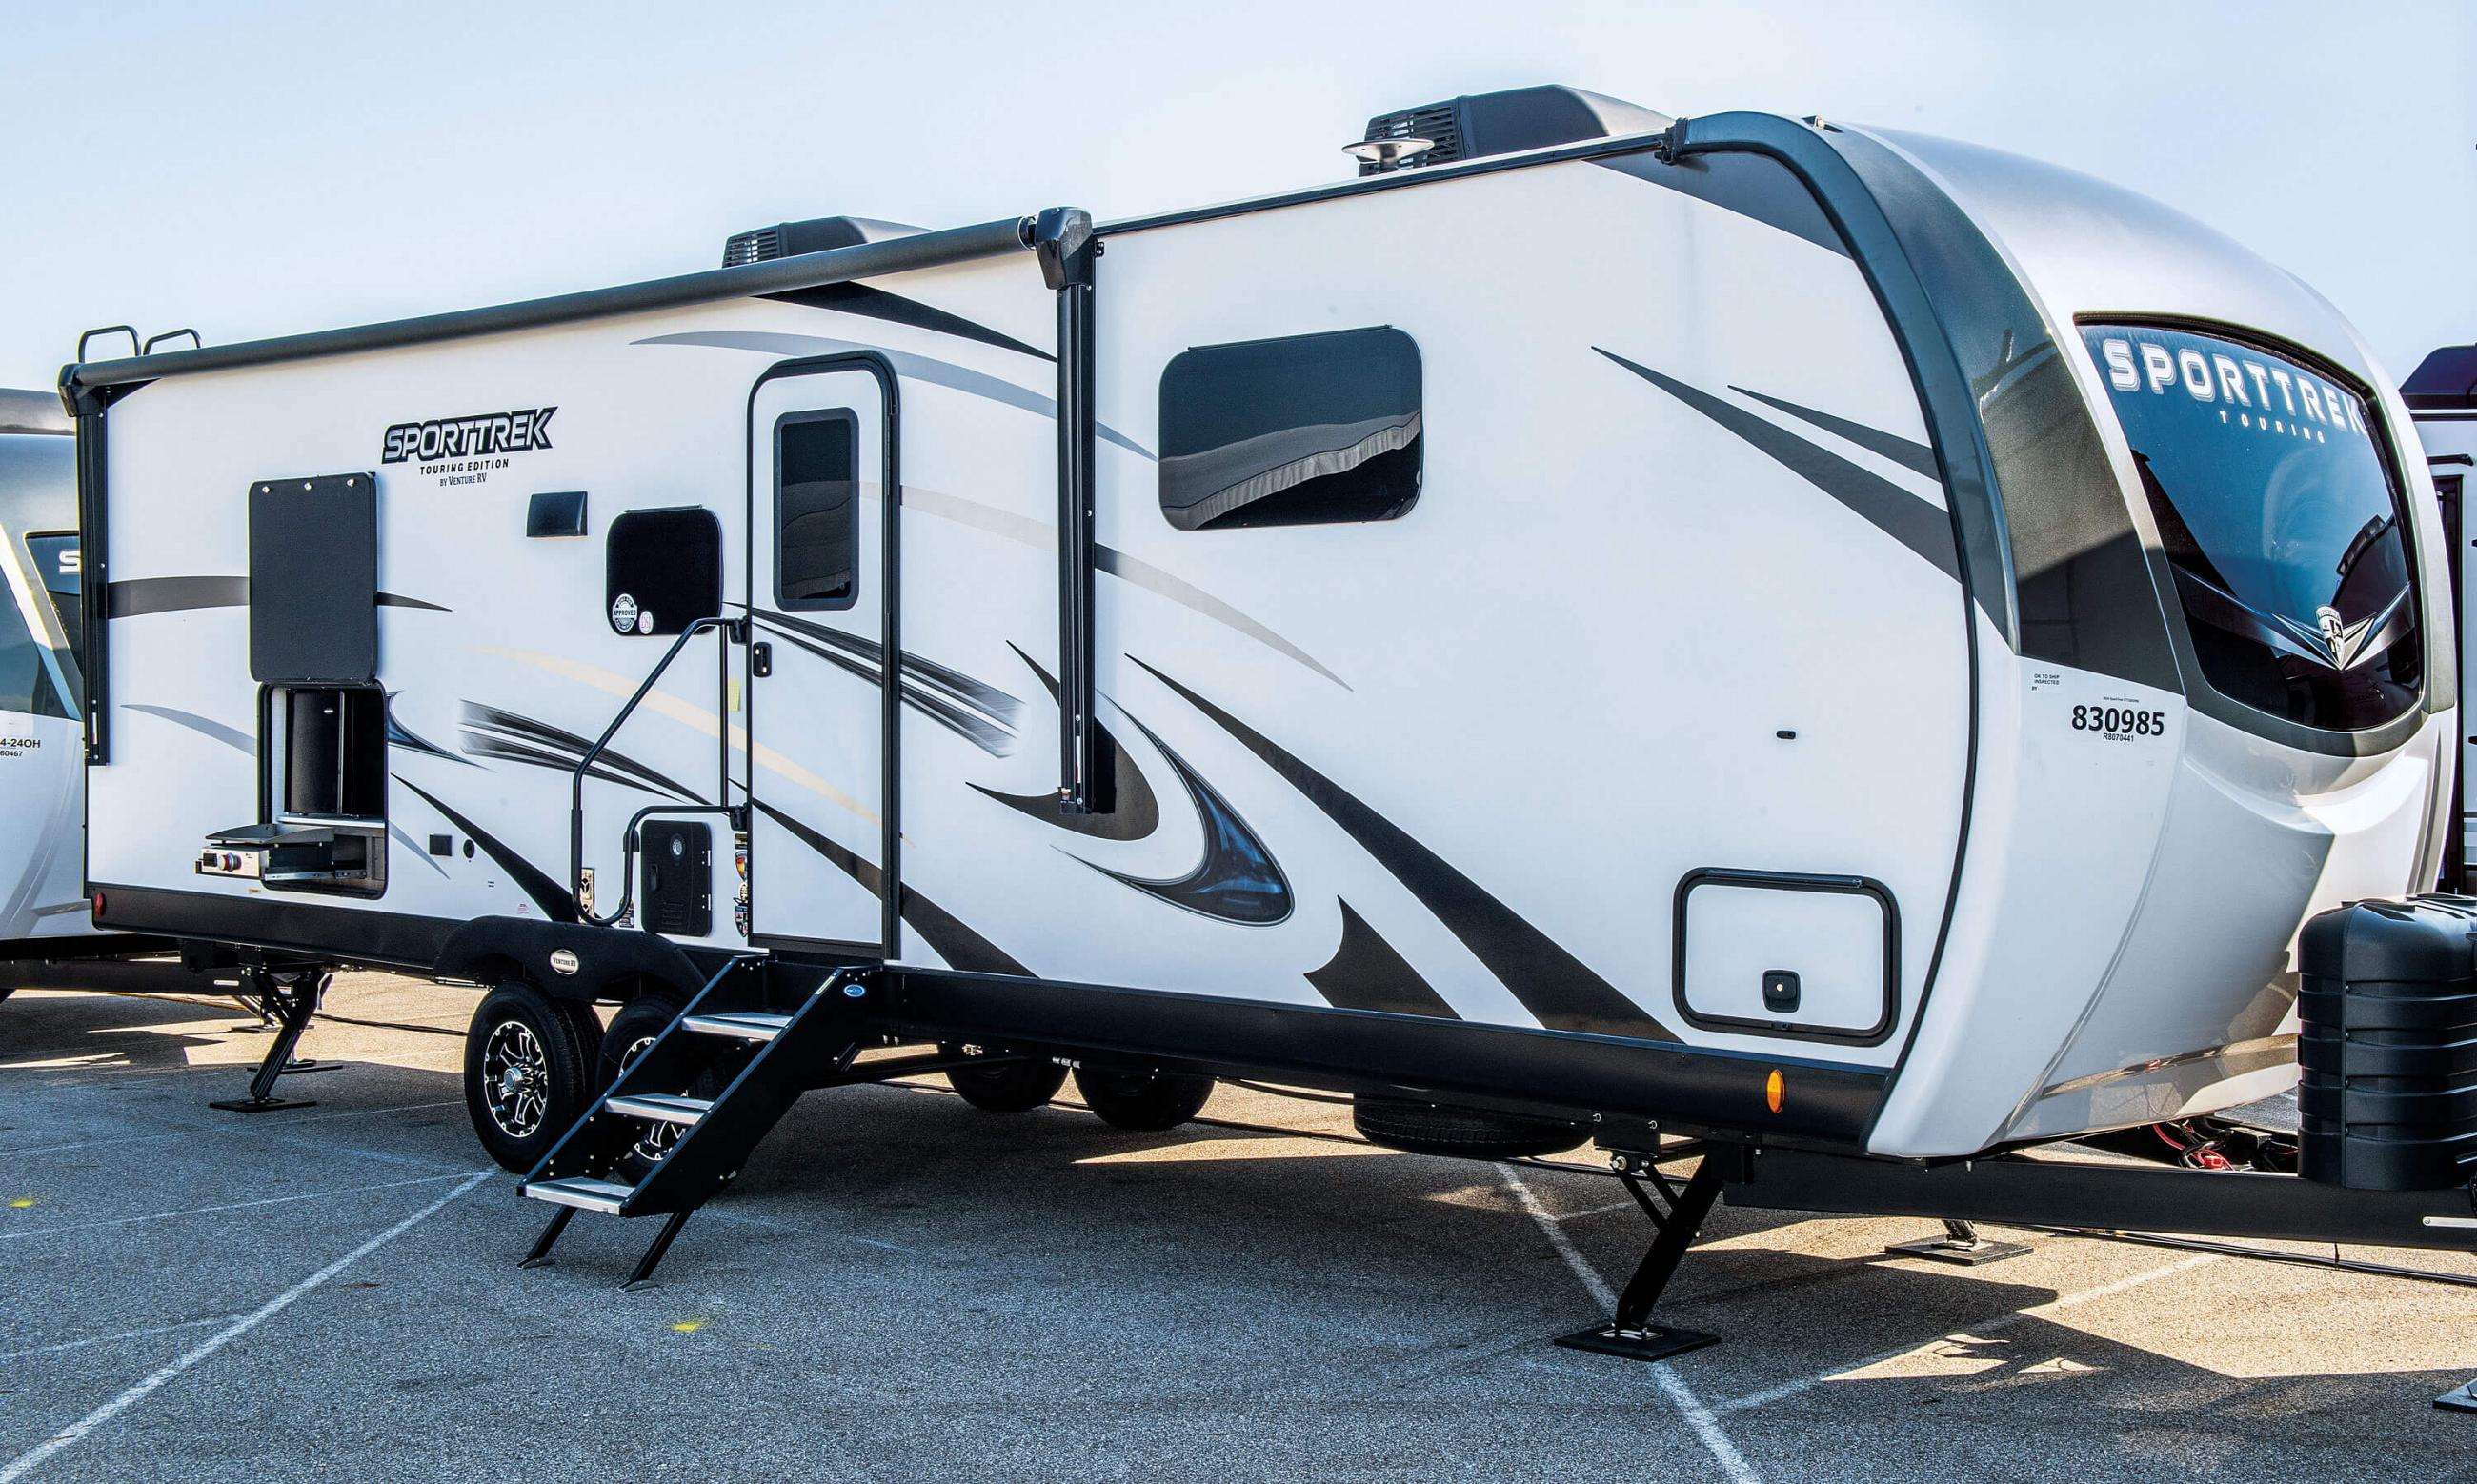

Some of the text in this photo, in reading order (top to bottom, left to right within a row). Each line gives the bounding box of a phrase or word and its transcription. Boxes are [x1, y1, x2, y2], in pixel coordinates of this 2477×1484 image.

[2103, 338, 2367, 437] SPORTTREK
[381, 406, 558, 464] SPORTTREK
[2219, 411, 2326, 444] TOURING
[419, 458, 510, 475] TOURING EDITION
[476, 472, 487, 484] RV
[2071, 705, 2165, 736] 830985
